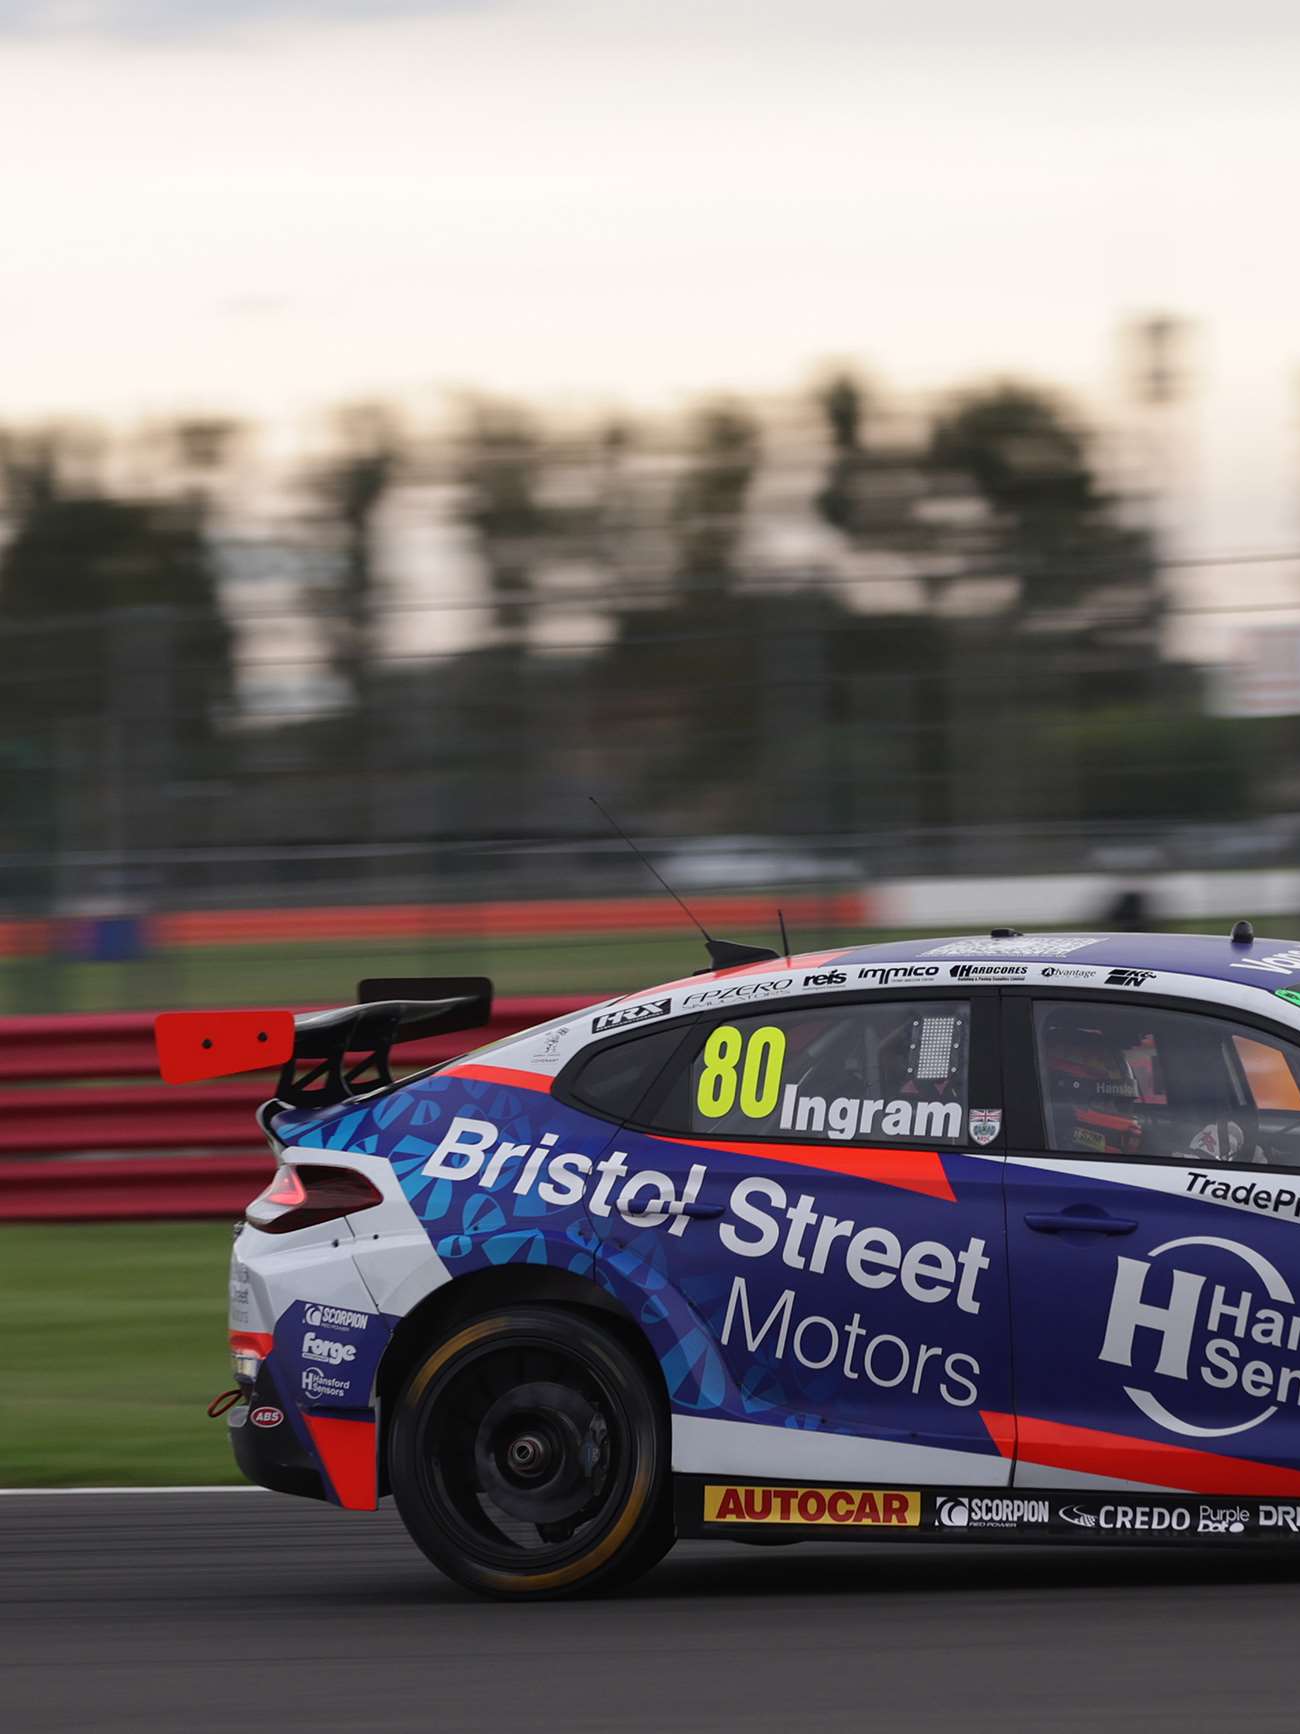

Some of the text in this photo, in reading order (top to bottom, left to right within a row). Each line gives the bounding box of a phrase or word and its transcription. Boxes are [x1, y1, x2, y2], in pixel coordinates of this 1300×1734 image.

[803, 969, 847, 986] reis
[958, 965, 1028, 978] HARDCORES
[596, 999, 669, 1029] HRX
[697, 1026, 786, 1119] 80
[779, 1083, 963, 1140] Ingram
[421, 1116, 991, 1315] Bristol Street
[322, 1307, 369, 1330] SCORPION
[1098, 1255, 1208, 1381] H
[302, 1331, 357, 1365] Forge
[720, 1276, 981, 1407] Motors
[312, 1383, 345, 1397] Sensors
[313, 1374, 351, 1389] Hansford
[255, 1411, 280, 1422] ABS
[715, 1487, 910, 1524] AUTOCAR
[971, 1498, 1049, 1523] SCORPION
[1099, 1505, 1191, 1531] CREDO
[1200, 1505, 1250, 1523] Purple
